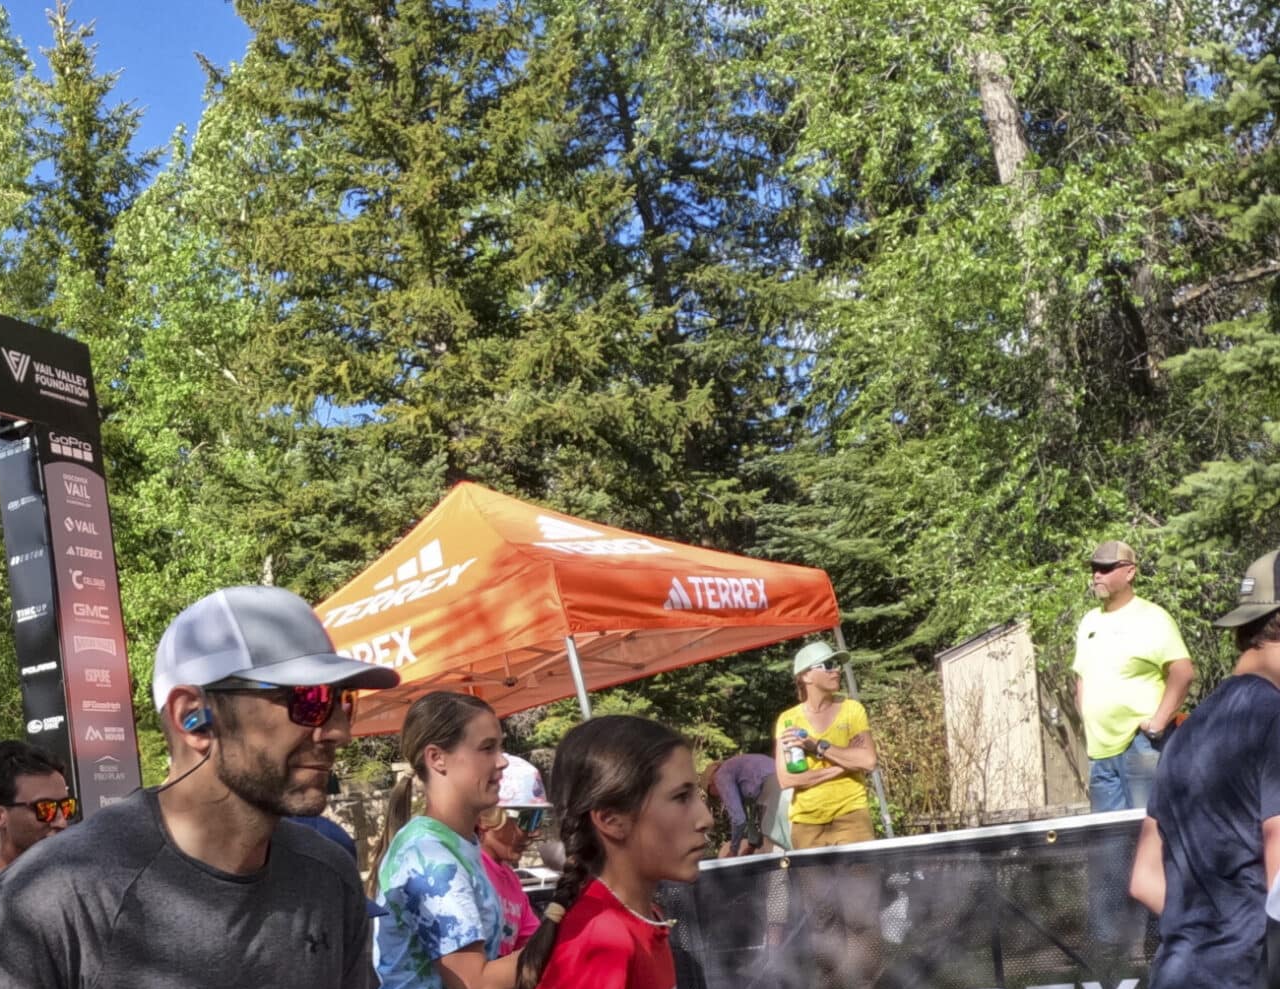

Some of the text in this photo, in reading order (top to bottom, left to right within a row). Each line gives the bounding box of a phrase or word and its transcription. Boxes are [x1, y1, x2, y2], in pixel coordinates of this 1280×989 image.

[33, 361, 87, 387] VAIL VALLEY
[35, 373, 89, 399] FOUNDATION
[49, 432, 92, 451] GoPro
[64, 480, 90, 500] VAIL
[75, 520, 99, 535] VAIL
[323, 558, 478, 628] TERREX
[687, 576, 768, 609] TERREX
[73, 602, 110, 619] GMC
